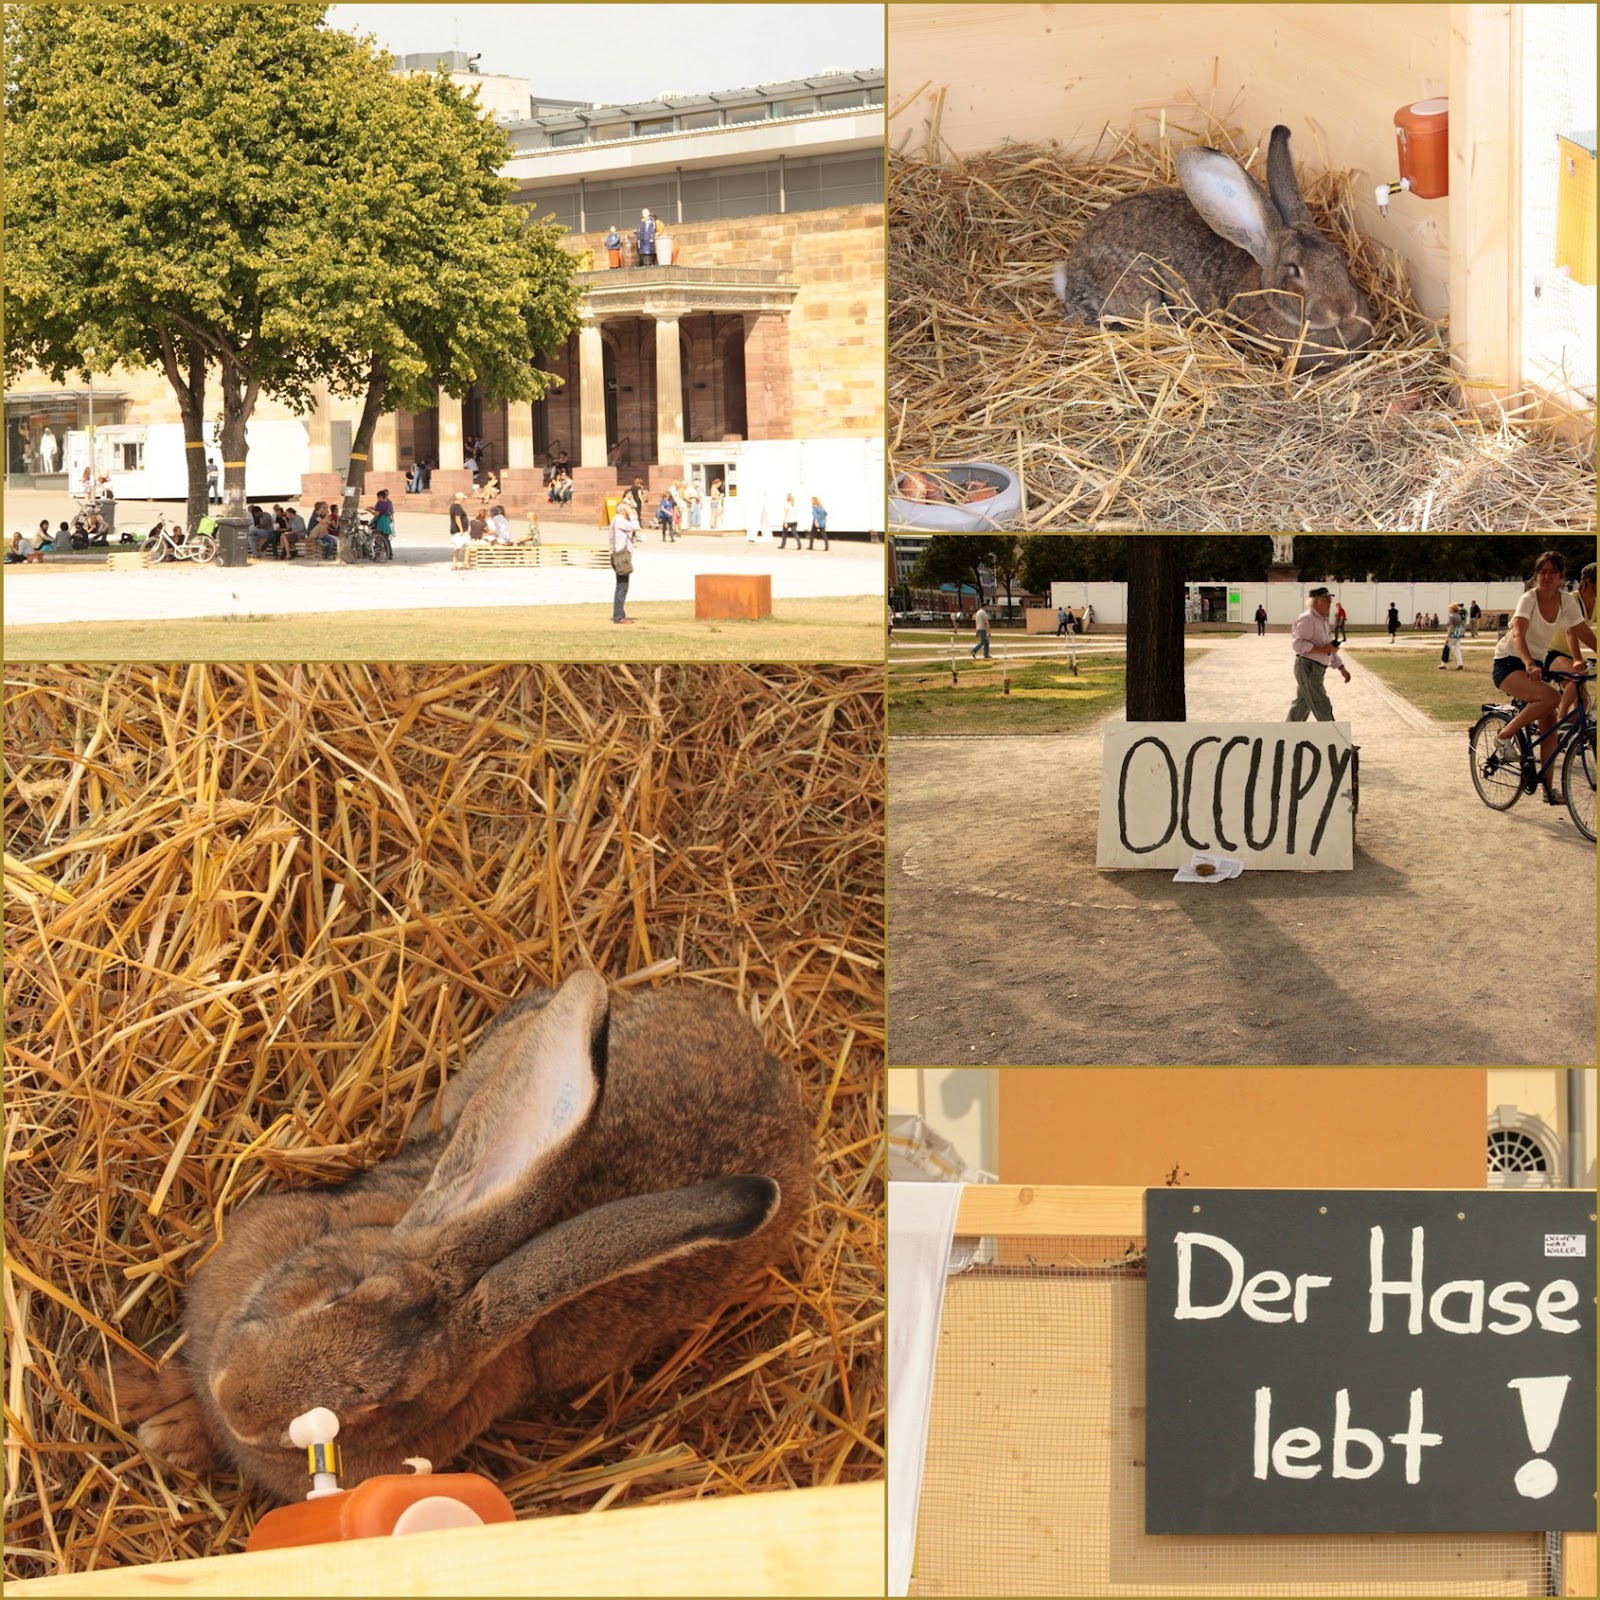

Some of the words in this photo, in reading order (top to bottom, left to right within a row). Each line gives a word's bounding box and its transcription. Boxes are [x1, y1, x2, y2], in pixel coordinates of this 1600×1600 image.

[1118, 736, 1350, 856] OCCUPY
[1174, 1231, 1333, 1324] Der
[1369, 1225, 1582, 1335] Hase
[1254, 1386, 1444, 1485] lebt
